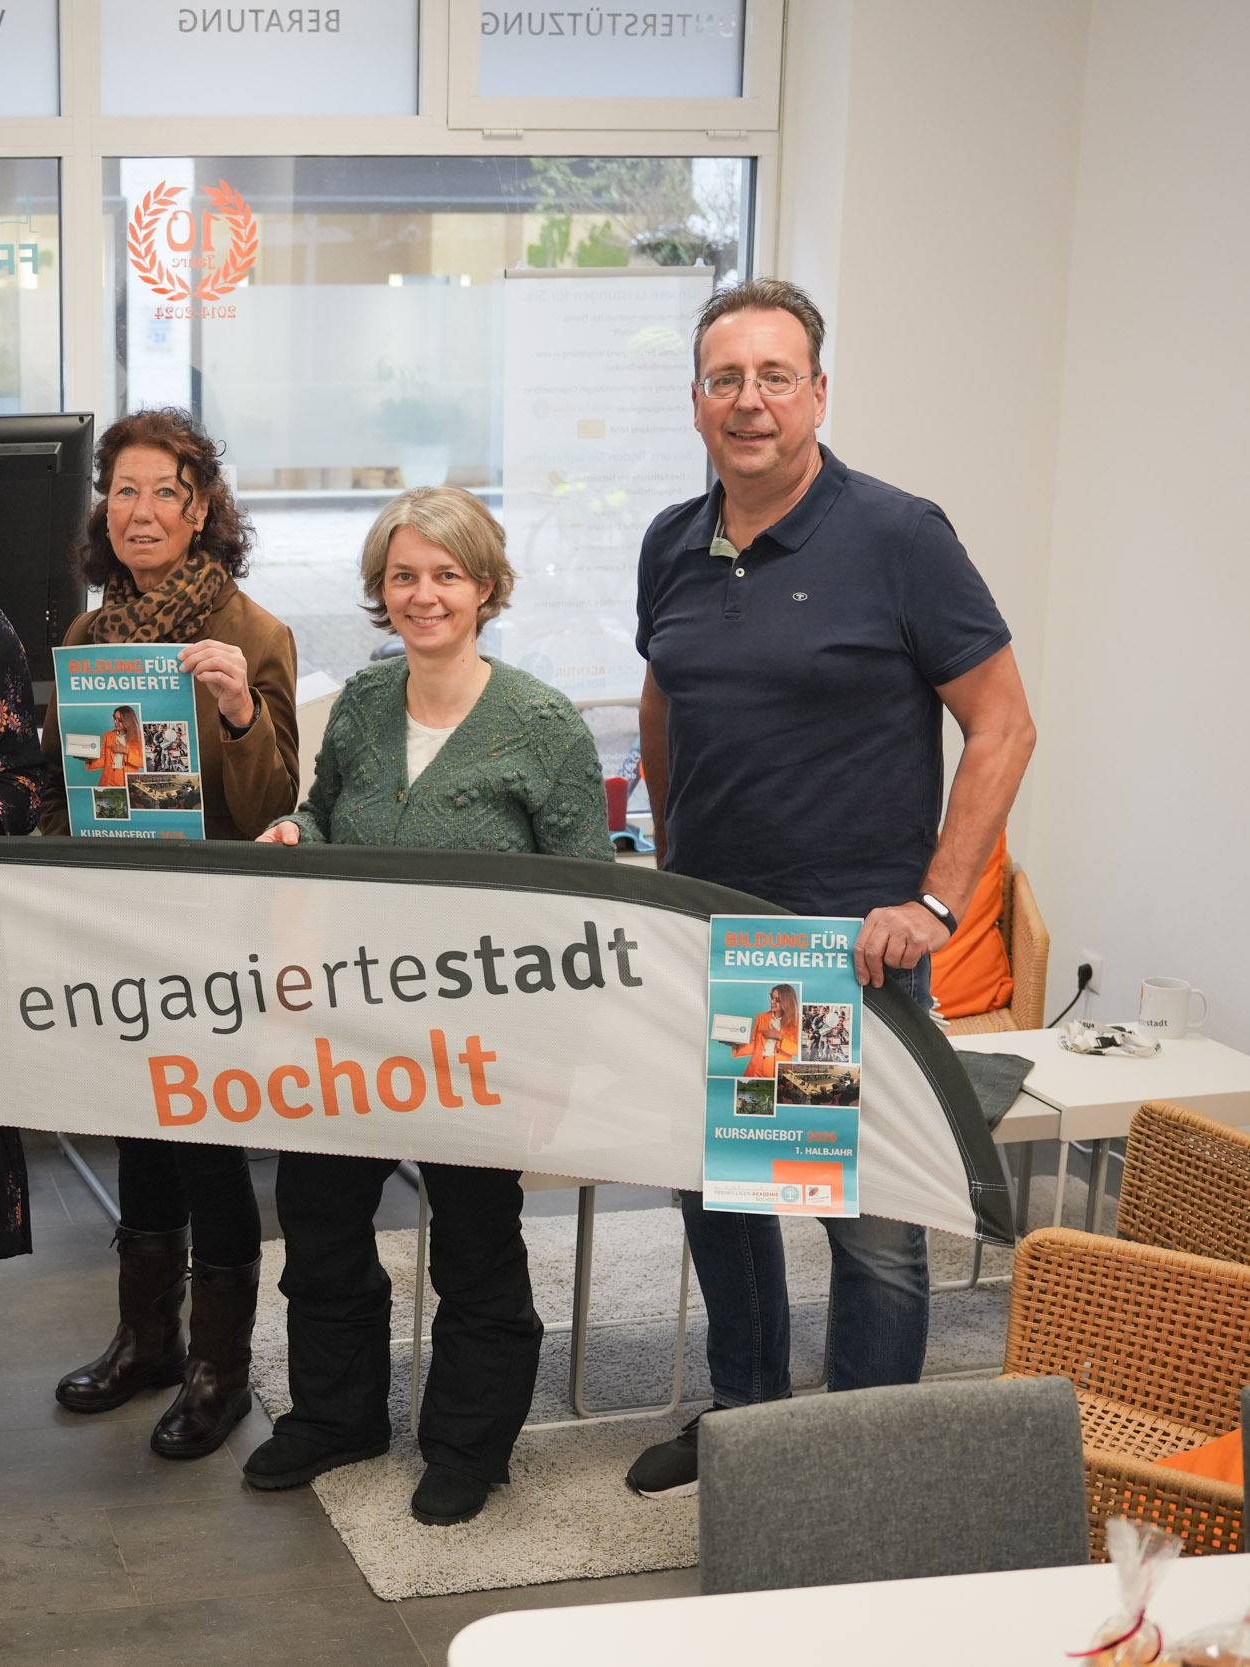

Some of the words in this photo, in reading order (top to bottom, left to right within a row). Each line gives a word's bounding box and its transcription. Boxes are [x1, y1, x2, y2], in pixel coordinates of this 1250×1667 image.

[69, 659, 143, 674] BILDUNG
[70, 676, 180, 691] ENGAGIERTE
[80, 829, 157, 839] KURSANGEBOT
[725, 932, 809, 949] BILDUNG
[810, 930, 848, 950] FÜR
[724, 950, 848, 969] ENGAGIERTE
[18, 920, 643, 1042] engagiertestadt
[147, 1028, 502, 1128] Bocholt
[714, 1127, 804, 1142] KURSANGEBOT
[806, 1131, 837, 1143] 2026
[795, 1146, 803, 1155] 1.
[805, 1147, 853, 1157] HALBJAHR
